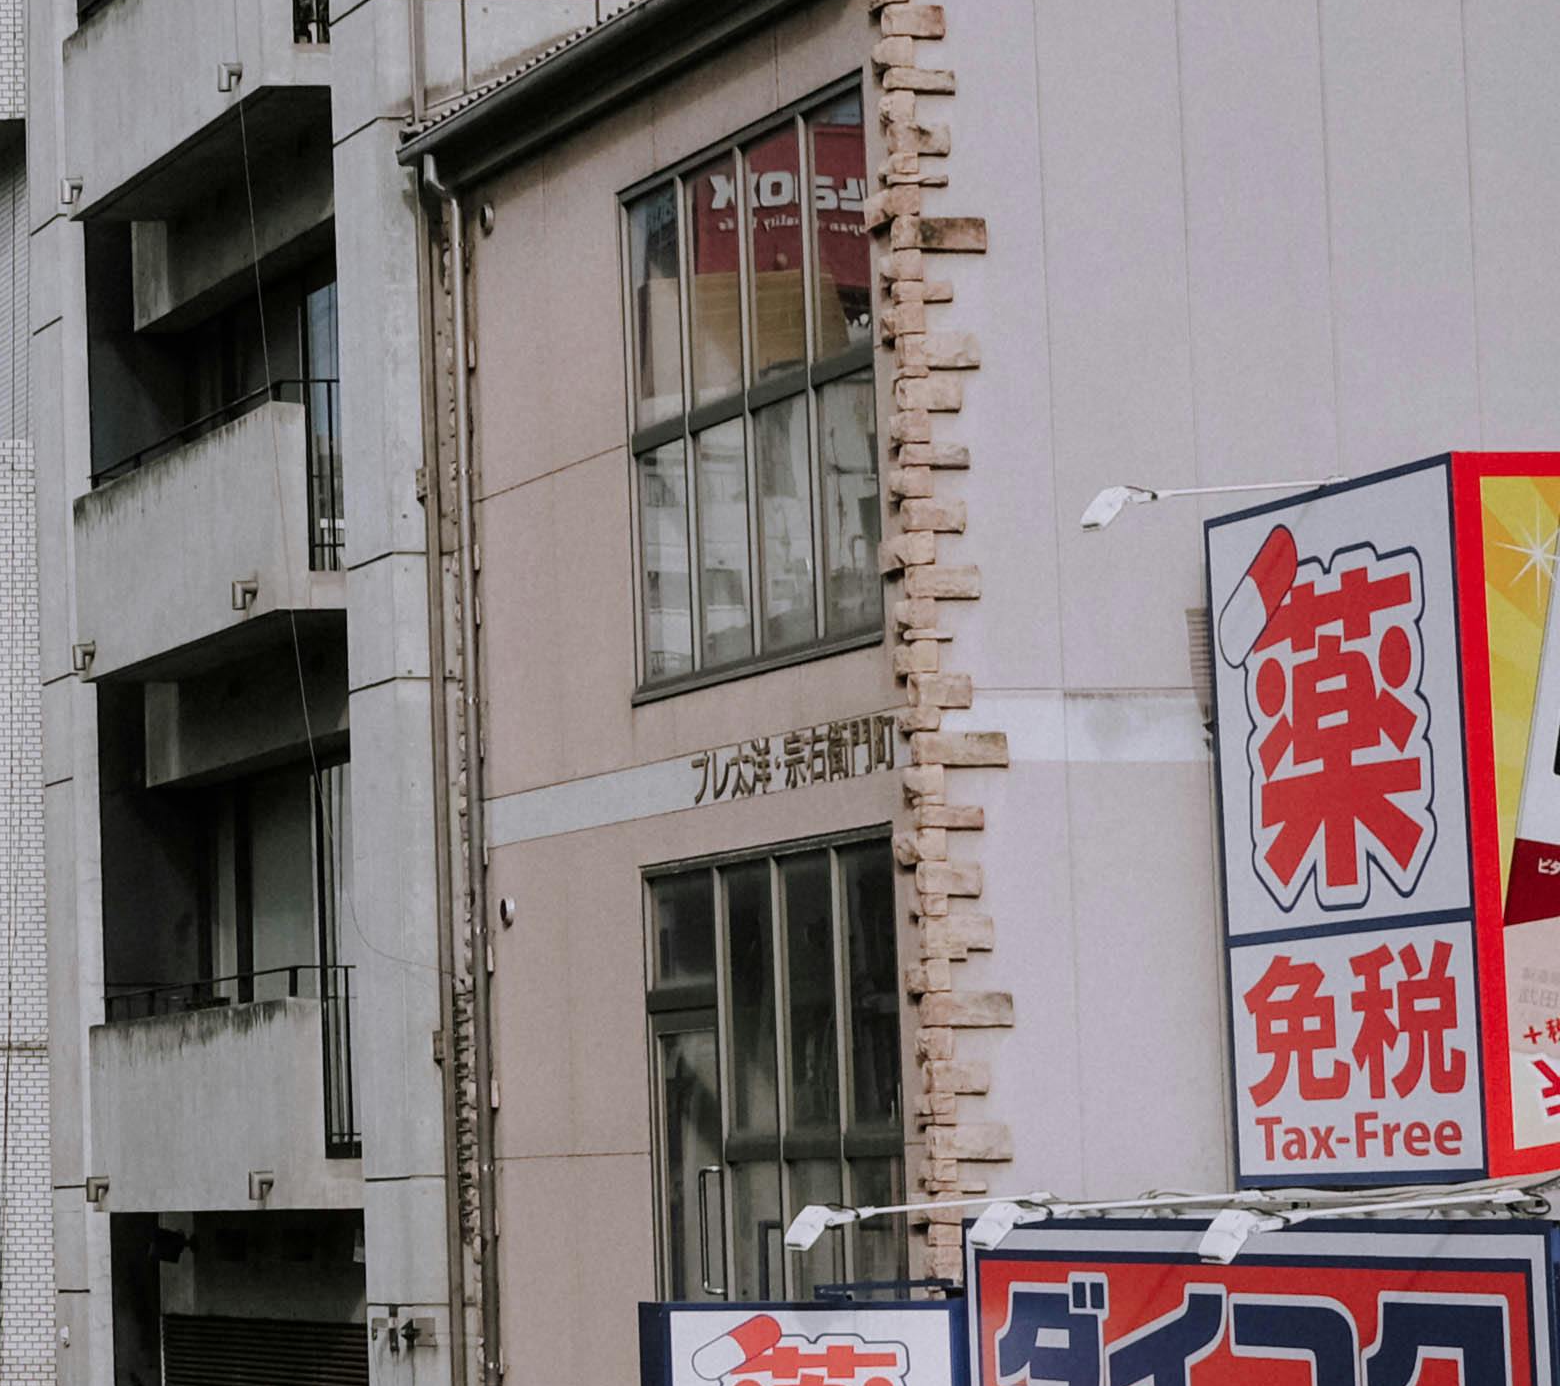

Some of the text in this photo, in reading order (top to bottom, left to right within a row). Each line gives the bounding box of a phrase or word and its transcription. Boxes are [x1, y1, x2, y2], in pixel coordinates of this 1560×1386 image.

[1249, 566, 1426, 891] 薬
[1244, 939, 1467, 1109] 免税
[1254, 1108, 1464, 1166] Tax-Free
